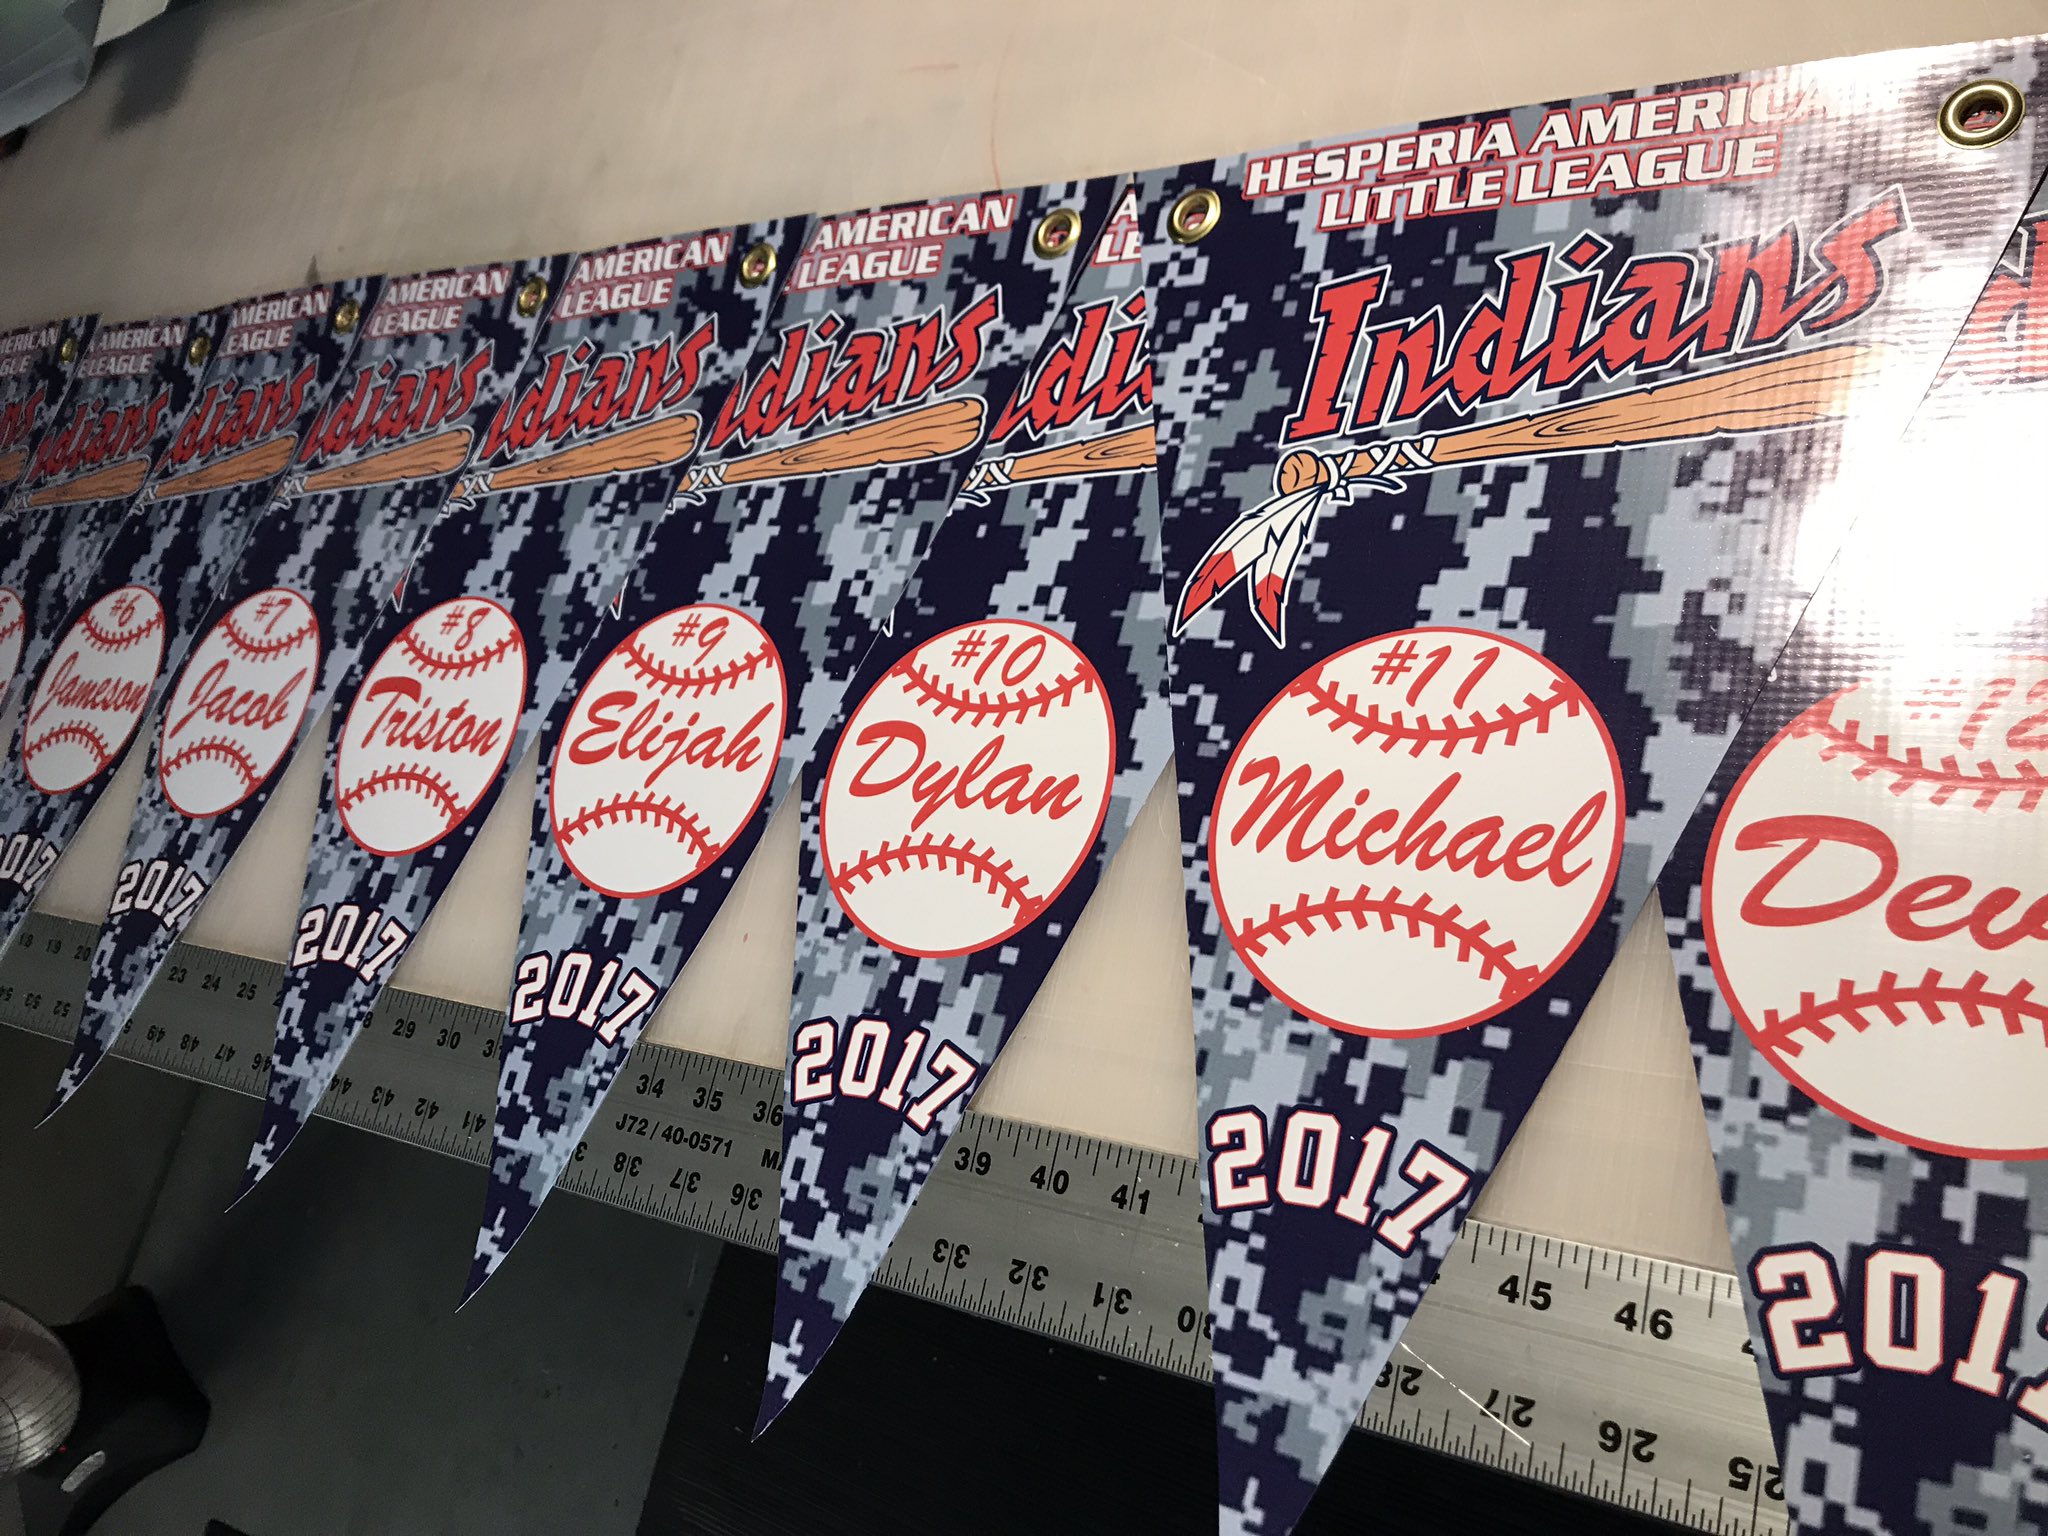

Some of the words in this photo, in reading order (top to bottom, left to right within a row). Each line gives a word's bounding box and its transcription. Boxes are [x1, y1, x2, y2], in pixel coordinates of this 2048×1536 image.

[1244, 120, 1517, 197] HESPERIA
[1318, 166, 1504, 232] LITTLE
[1515, 134, 1781, 204] LEAGUE
[808, 196, 1016, 254] AMERICAN
[572, 235, 729, 284] AMERICAN
[796, 243, 943, 291] LEAGUE
[385, 268, 510, 306] AMERICAN
[558, 277, 674, 320] LEAGUE
[371, 303, 462, 337] LEAGUE
[1285, 187, 1910, 446] Indians
[99, 325, 185, 352] AMERICAN
[110, 593, 142, 628] #6
[254, 594, 293, 636] #7
[440, 604, 492, 651] #8
[671, 612, 729, 666] #9
[950, 628, 1047, 686] #10
[30, 651, 149, 726] Jameson
[1370, 639, 1502, 710] #11
[168, 657, 308, 740] Jacob
[360, 675, 503, 757] Triston
[568, 690, 776, 788] Elijah
[848, 719, 1083, 832] Dylan
[1230, 755, 1608, 888] Michael
[109, 859, 207, 931] 2017
[74, 946, 91, 962] 20
[291, 905, 409, 983] 2017
[168, 965, 187, 984] 23
[202, 974, 221, 992] 24
[236, 982, 257, 1000] 25
[511, 951, 656, 1044] 2017
[146, 1024, 165, 1043] 49
[180, 1033, 200, 1053] 48
[392, 1018, 417, 1039] 29
[437, 1028, 461, 1050] 30
[214, 1043, 236, 1062] 47
[330, 1073, 353, 1095] 44
[635, 1073, 666, 1099] 34
[793, 1019, 979, 1132] 2017
[371, 1085, 395, 1107] 43
[414, 1097, 440, 1120] 42
[692, 1086, 724, 1112] 35
[752, 1100, 784, 1127] 36
[461, 1110, 487, 1133] 41
[614, 1112, 650, 1137] J72
[660, 1122, 734, 1158] 40-0571
[613, 1151, 643, 1178] 38
[953, 1146, 992, 1176] 39
[1029, 1164, 1070, 1195] 40
[669, 1167, 701, 1194] 37
[729, 1182, 763, 1212] 36
[1110, 1183, 1151, 1215] 41
[1209, 1109, 1471, 1252] 2017
[932, 1238, 971, 1270] 33
[1007, 1257, 1050, 1292] 32
[1497, 1273, 1552, 1311] 45
[1092, 1281, 1133, 1315] 31
[1613, 1300, 1674, 1341] 46
[1479, 1388, 1538, 1429] 27
[1597, 1419, 1659, 1464] 26
[1727, 1456, 1787, 1502] 25
